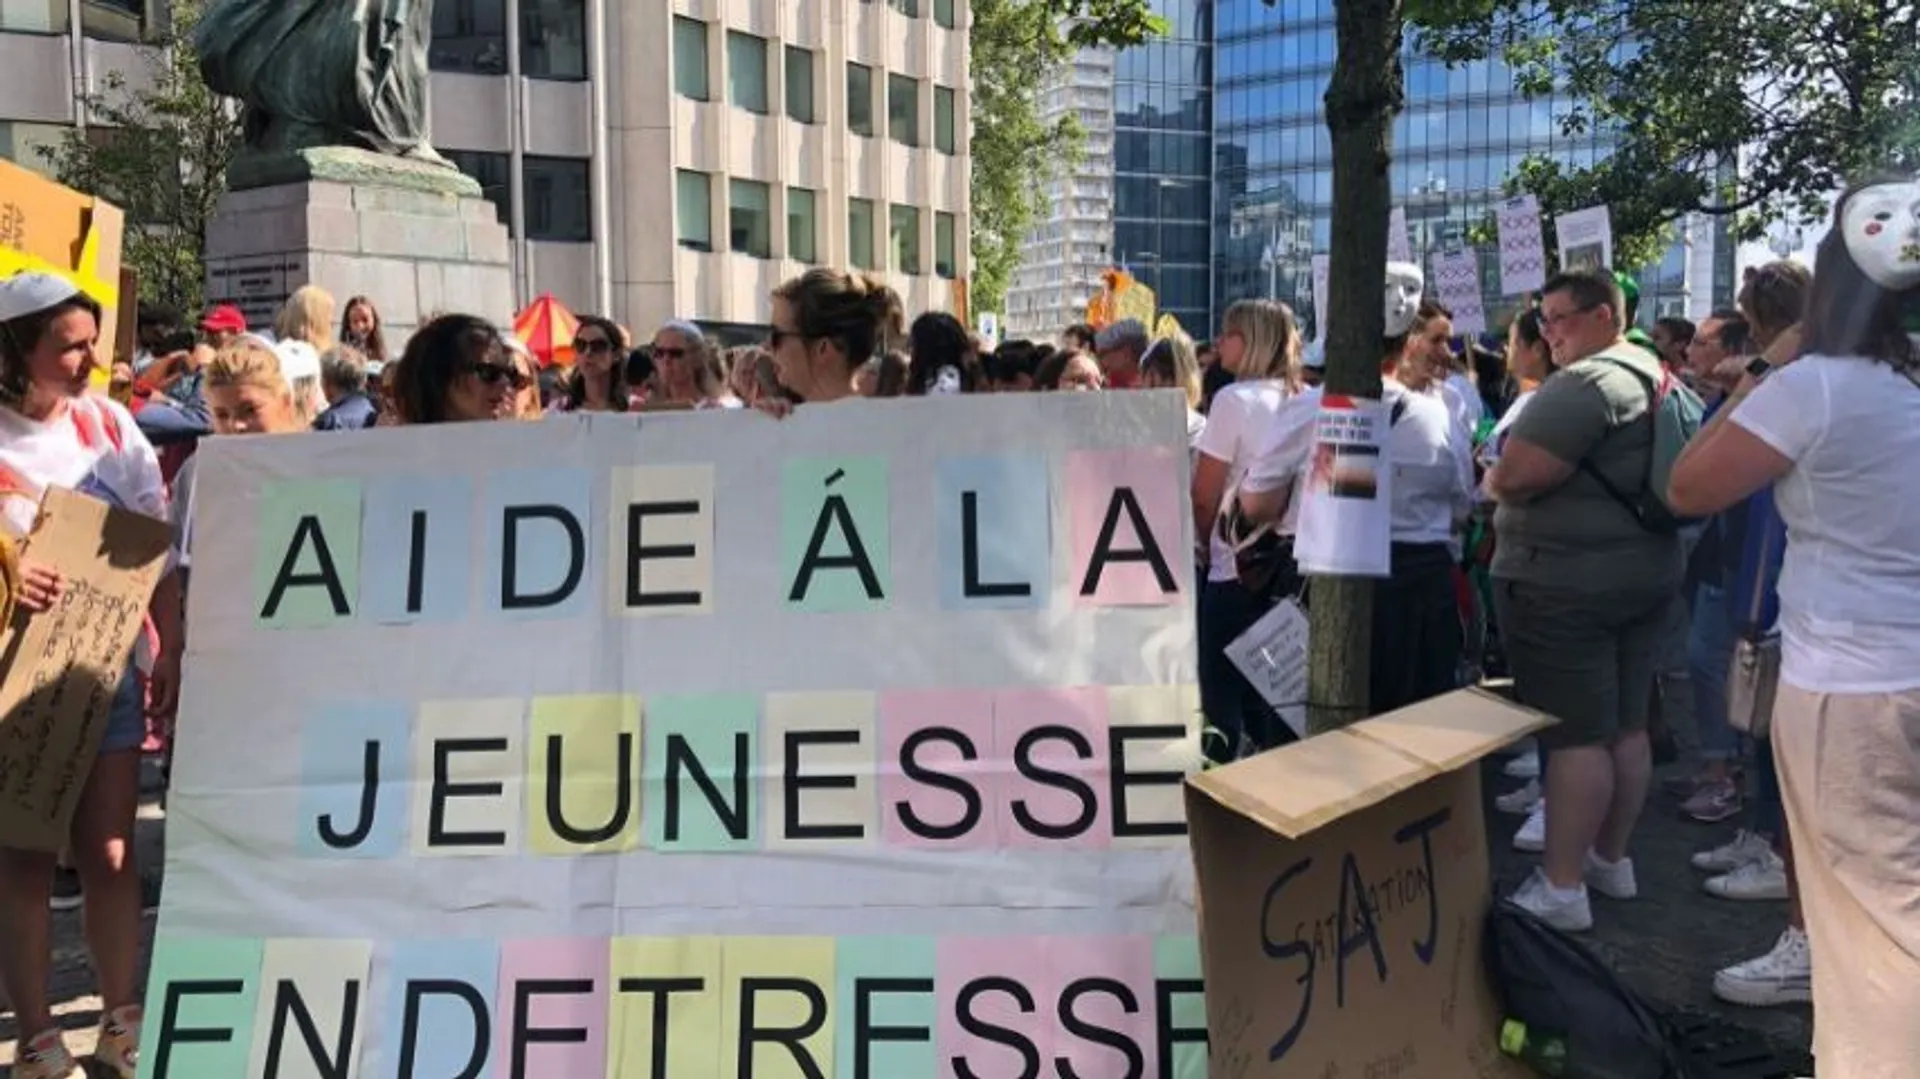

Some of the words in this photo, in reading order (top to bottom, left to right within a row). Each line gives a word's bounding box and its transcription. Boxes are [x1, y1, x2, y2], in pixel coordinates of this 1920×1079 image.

[260, 501, 702, 618] AIDE
[788, 468, 885, 601] Á
[961, 487, 1179, 597] LA
[316, 724, 1188, 849] JEUNESSE
